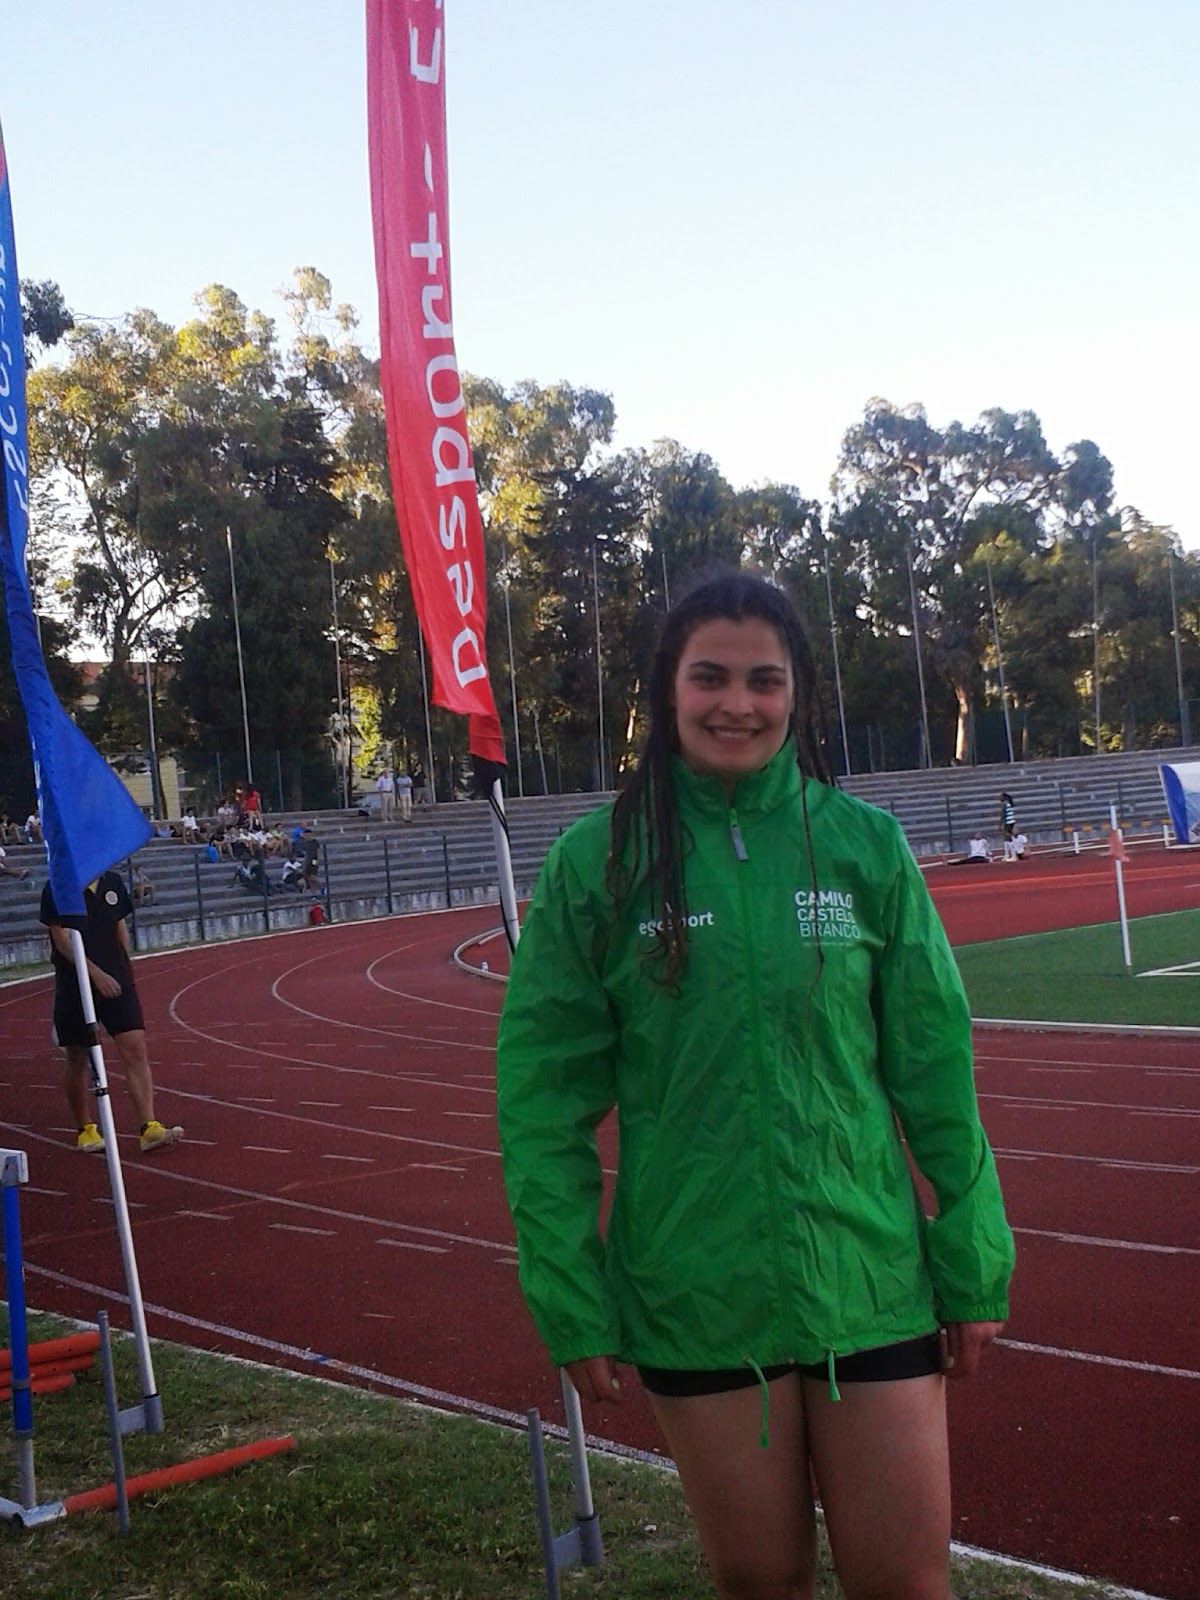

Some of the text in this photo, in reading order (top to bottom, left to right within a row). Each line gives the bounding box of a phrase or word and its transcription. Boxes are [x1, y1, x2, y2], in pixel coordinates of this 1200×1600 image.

[409, 142, 488, 689] Desport
[794, 890, 852, 909] CAMILO
[799, 922, 861, 939] BRANCO
